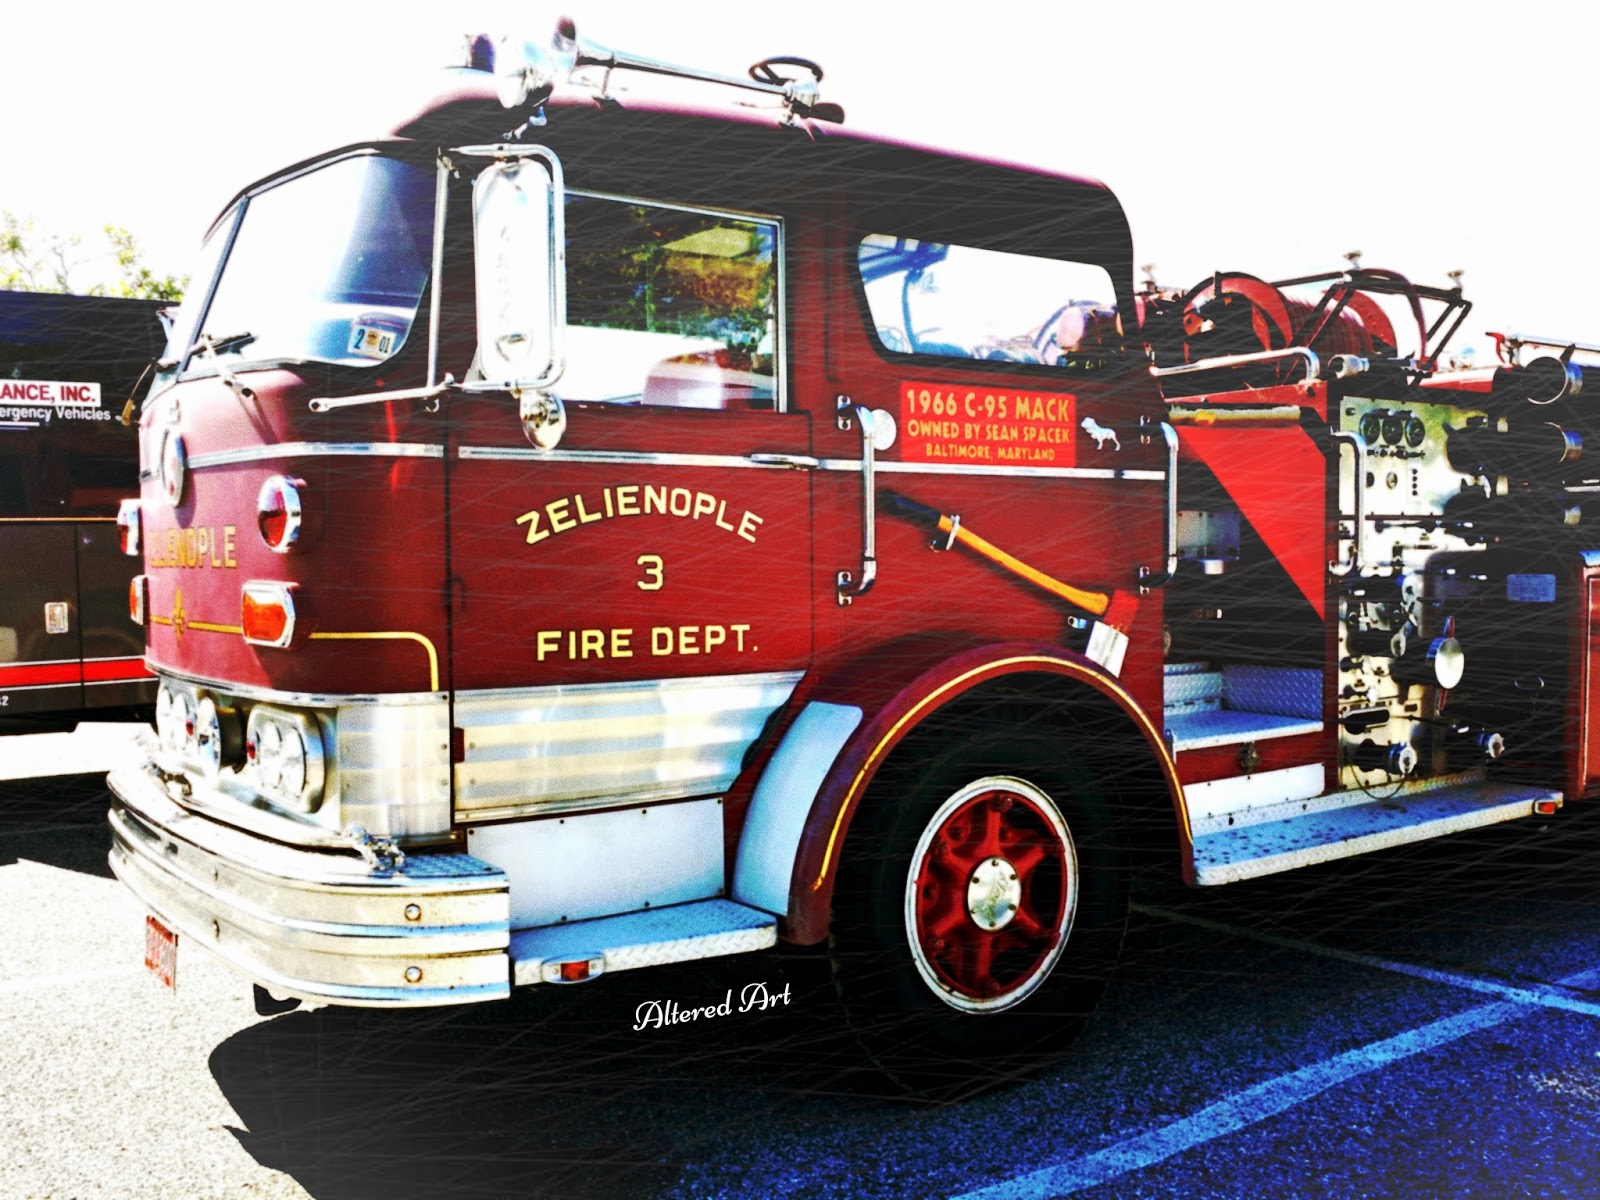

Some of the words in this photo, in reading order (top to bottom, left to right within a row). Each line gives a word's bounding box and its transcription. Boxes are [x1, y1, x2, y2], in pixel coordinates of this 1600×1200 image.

[354, 328, 365, 349] 2
[0, 384, 55, 403] ANCE,
[60, 386, 96, 402] INC.
[55, 406, 111, 420] Vehicles
[906, 389, 957, 416] 1966
[965, 392, 1007, 419] C-95
[1015, 395, 1069, 422] MACK
[907, 418, 960, 439] OWNED
[964, 422, 981, 440] BY
[985, 423, 1019, 441] SEAN
[1023, 426, 1070, 444] SPACEK
[925, 442, 994, 461] BALTIMORE,
[997, 446, 1056, 461] MARYLAND
[515, 484, 764, 545] ZELIENOPLE
[636, 554, 664, 590] 3
[536, 628, 634, 662] FIRE
[651, 624, 759, 656] DEPT.
[0, 695, 9, 706] 2
